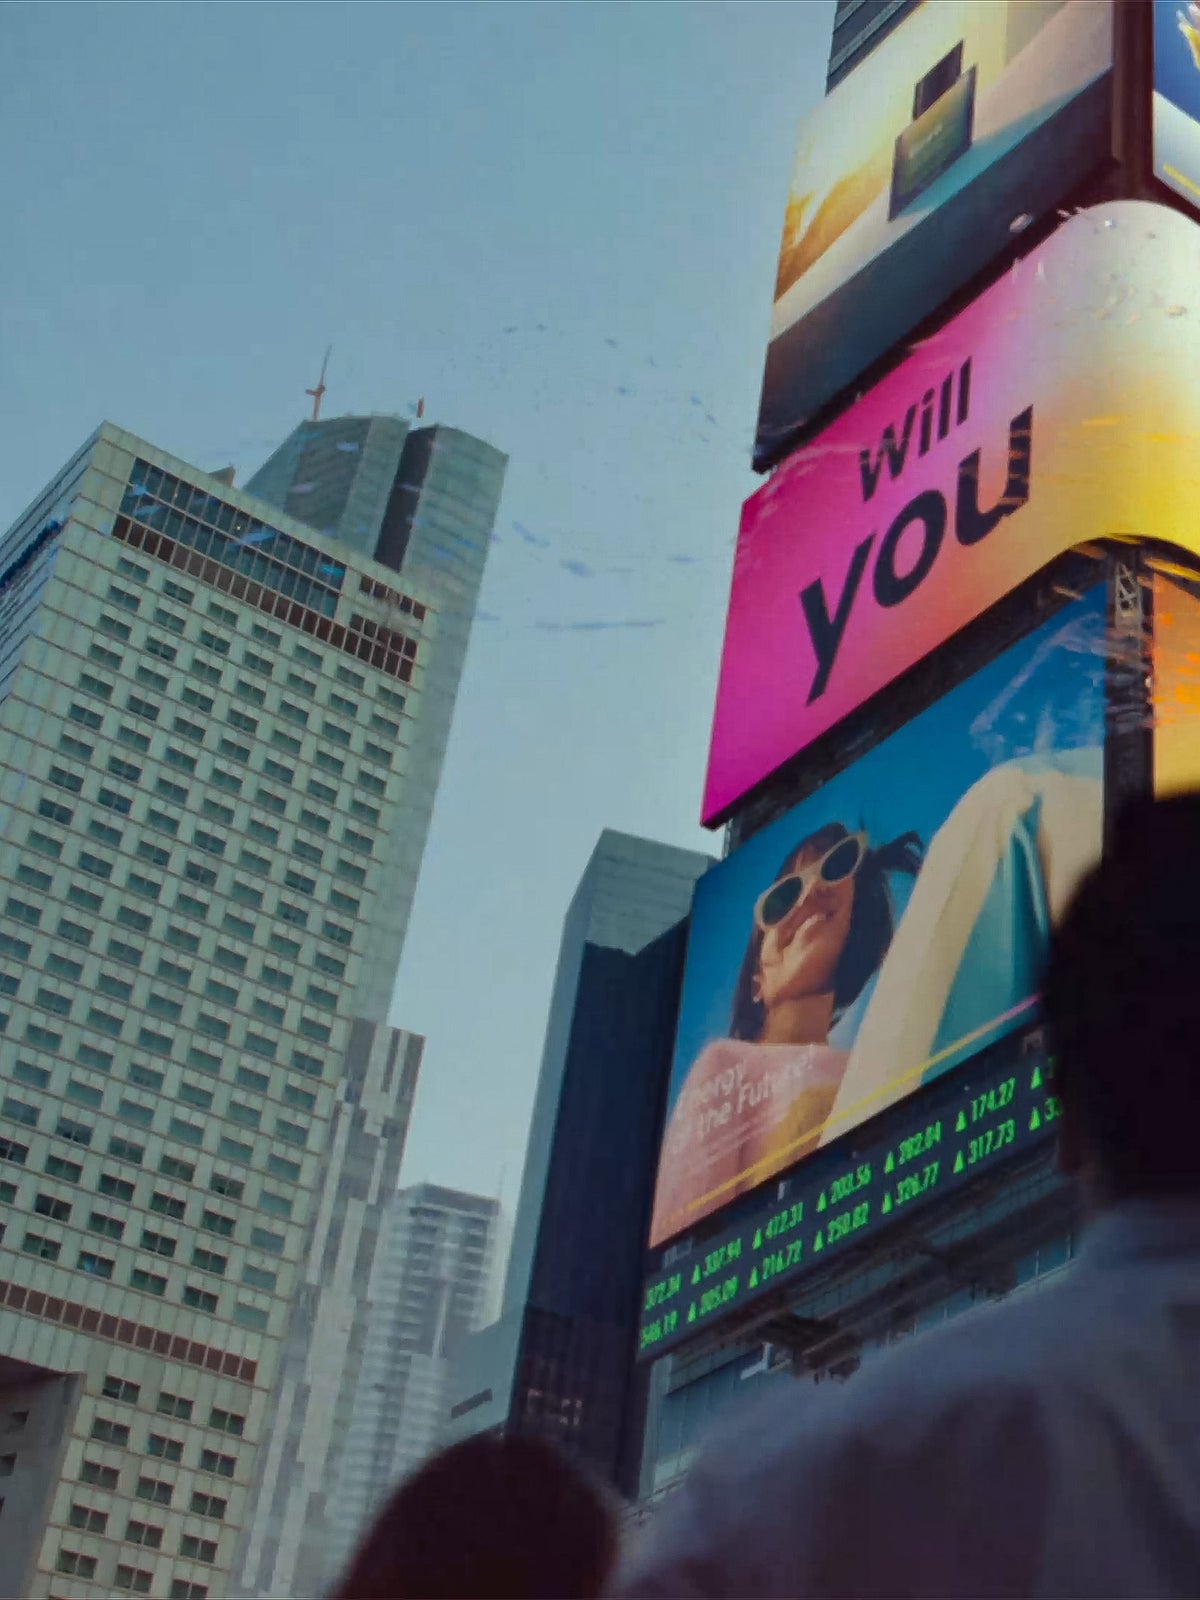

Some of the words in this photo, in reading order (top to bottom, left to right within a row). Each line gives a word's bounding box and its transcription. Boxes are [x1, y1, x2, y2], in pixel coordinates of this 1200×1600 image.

[859, 355, 973, 502] will
[798, 403, 1034, 707] you
[967, 1118, 1016, 1164] 317.73
